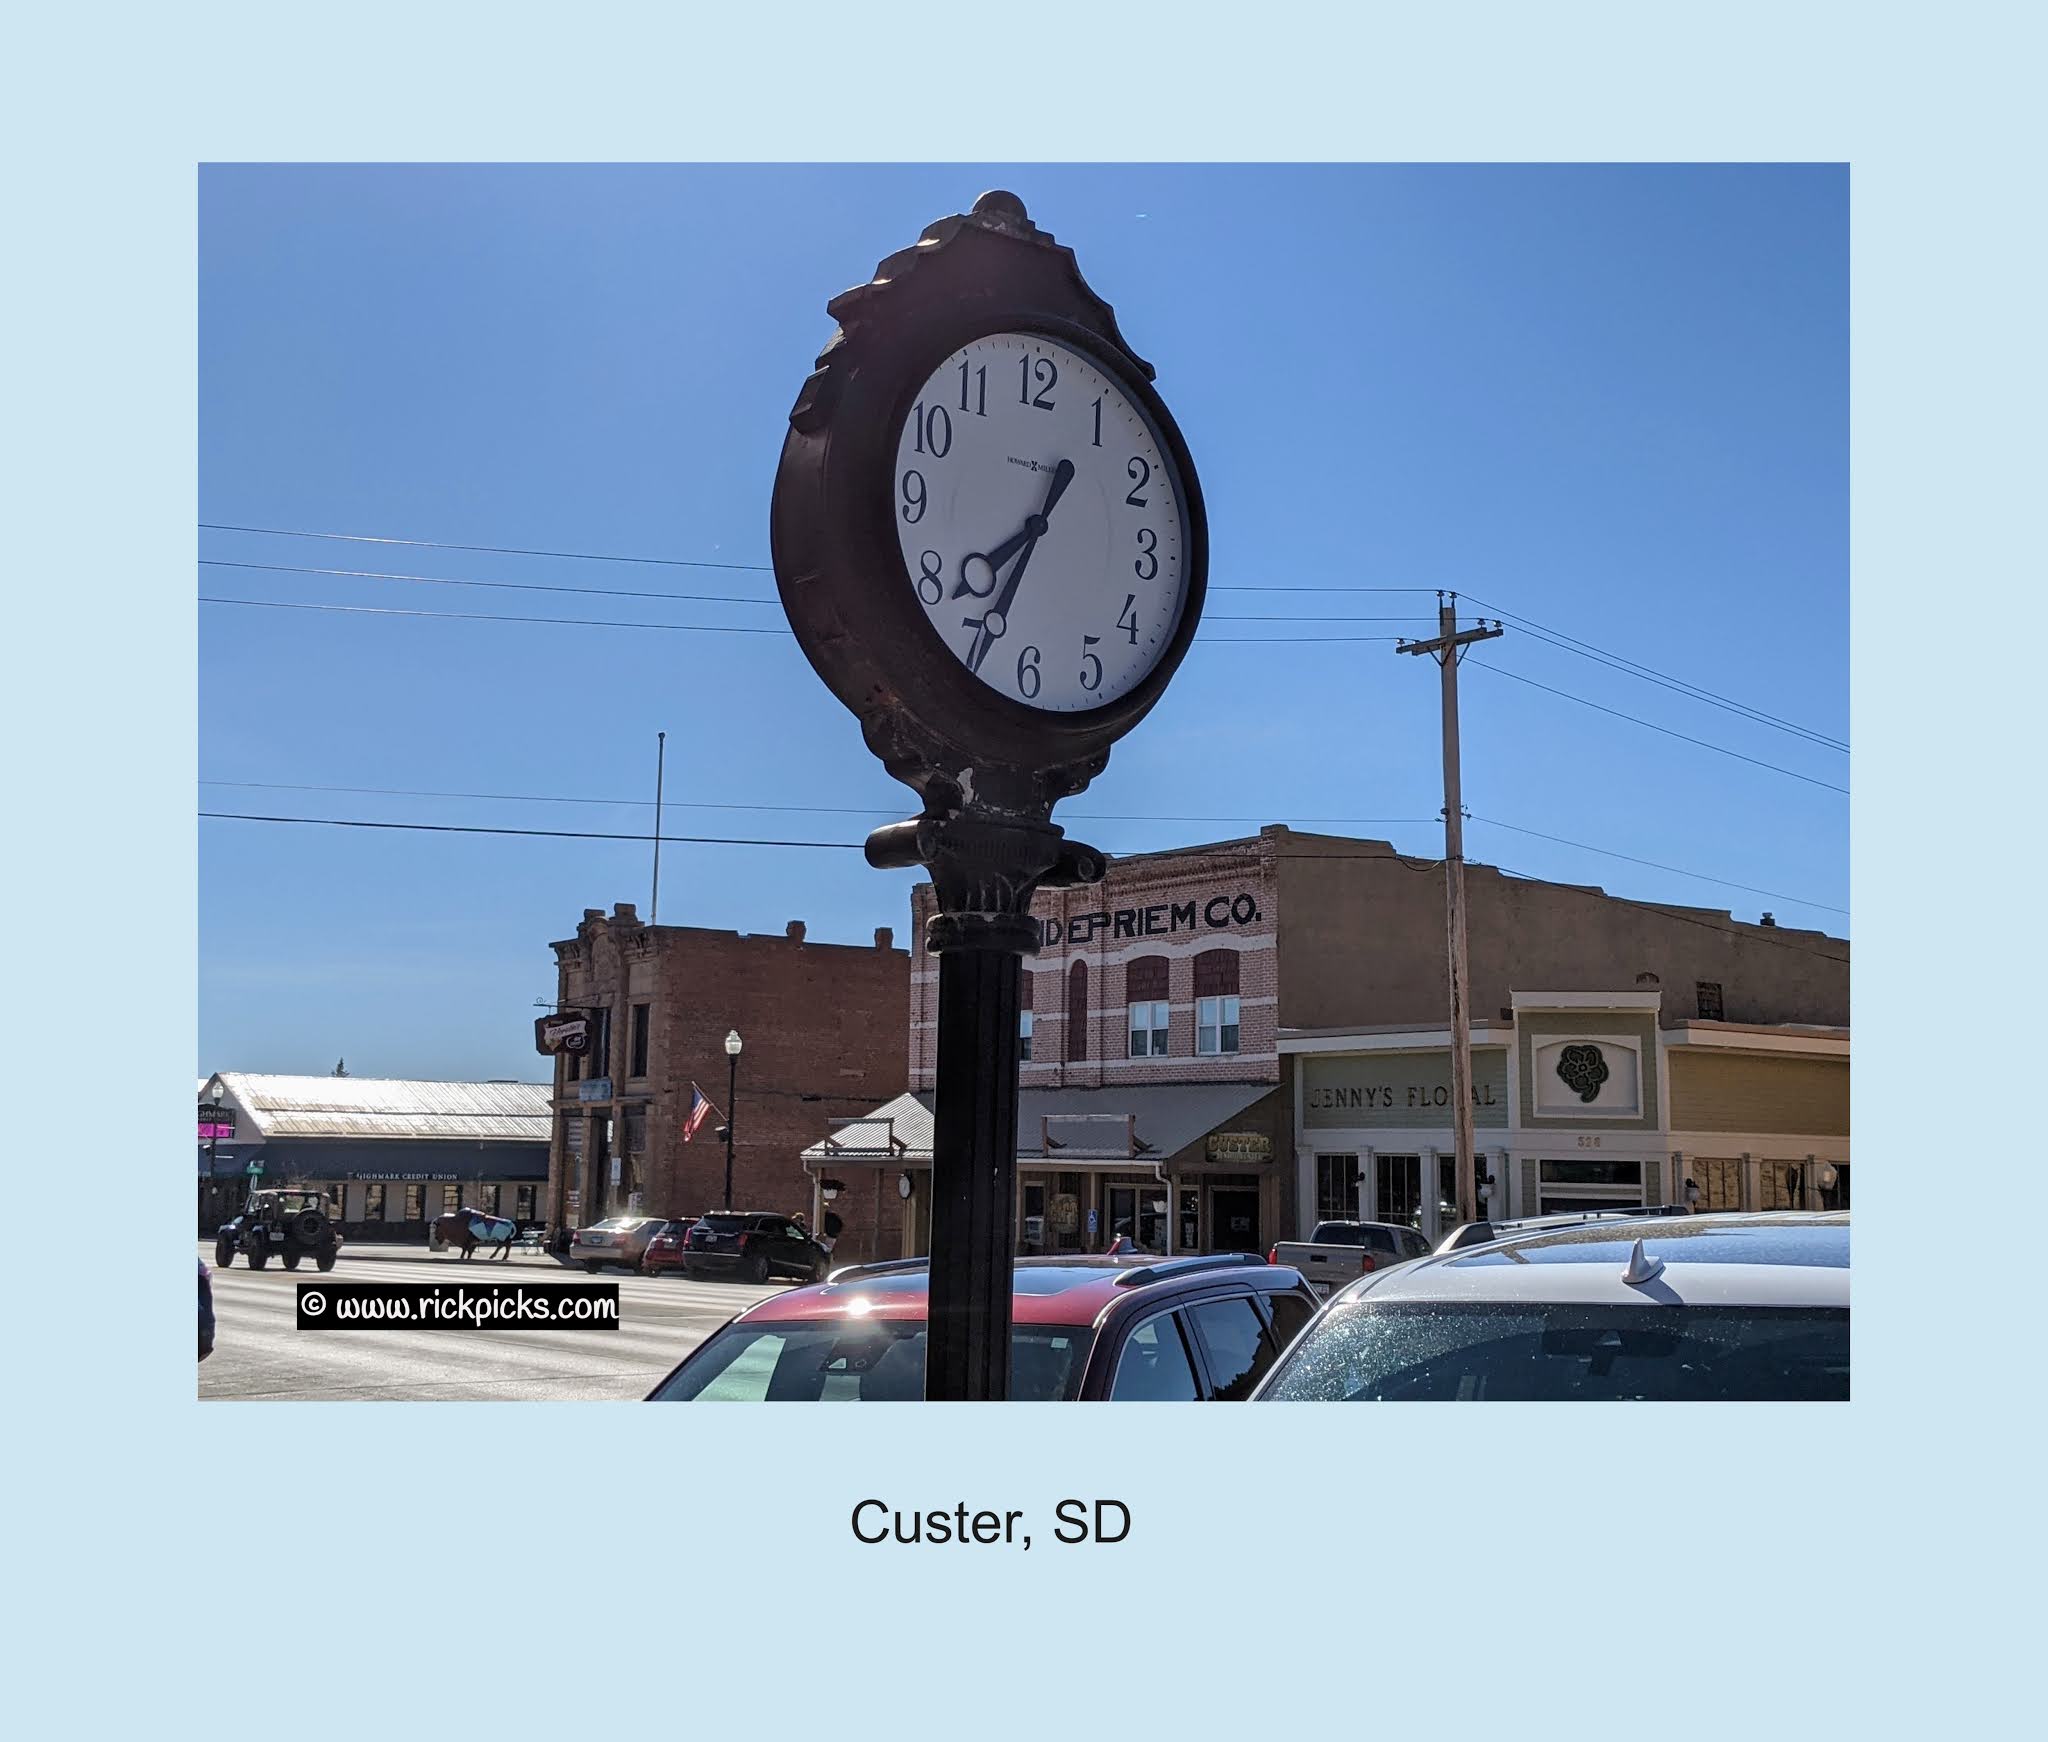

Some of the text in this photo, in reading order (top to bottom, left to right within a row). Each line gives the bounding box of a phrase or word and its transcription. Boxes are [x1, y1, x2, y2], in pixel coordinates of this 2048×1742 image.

[957, 359, 987, 417] 11
[1018, 353, 1059, 411] 12
[912, 400, 952, 458] 10
[1091, 396, 1103, 448] 1
[902, 470, 927, 524] 9
[1125, 456, 1151, 508] 2
[917, 550, 943, 605] 8
[1134, 528, 1159, 581] 3
[962, 617, 986, 669] 7
[1116, 593, 1140, 645] 4
[1017, 646, 1041, 699] 6
[1079, 635, 1103, 691] 5
[1203, 893, 1262, 928] CO.
[1311, 1084, 1497, 1109] JENNY'S FLOAL
[356, 1172, 400, 1180] HIGHMARK
